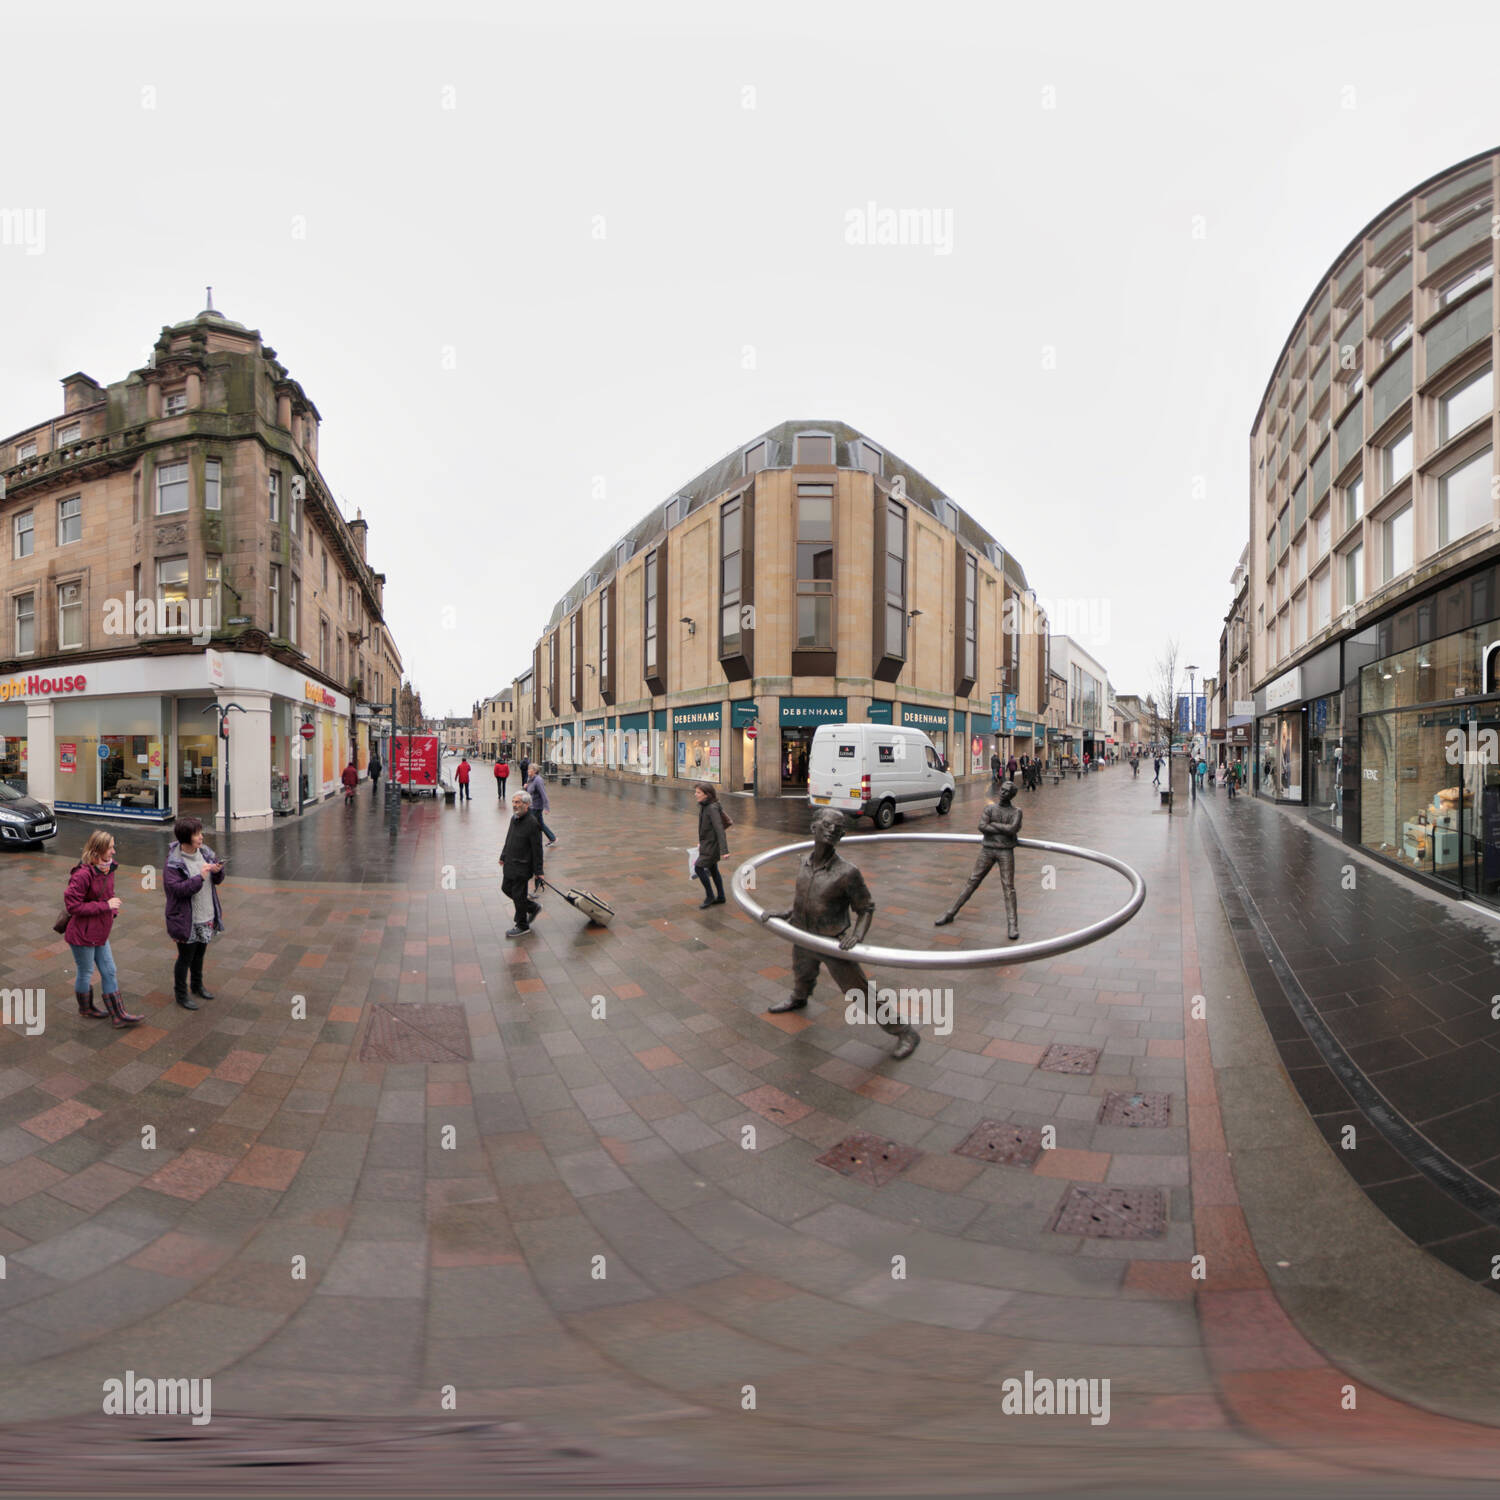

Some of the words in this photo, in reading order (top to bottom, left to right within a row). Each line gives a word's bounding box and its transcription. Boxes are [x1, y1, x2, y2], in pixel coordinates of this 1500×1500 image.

[674, 712, 719, 724] DEBENHAMS
[783, 708, 844, 716] DEBENHAMS
[904, 712, 947, 724] DEBENHAMS
